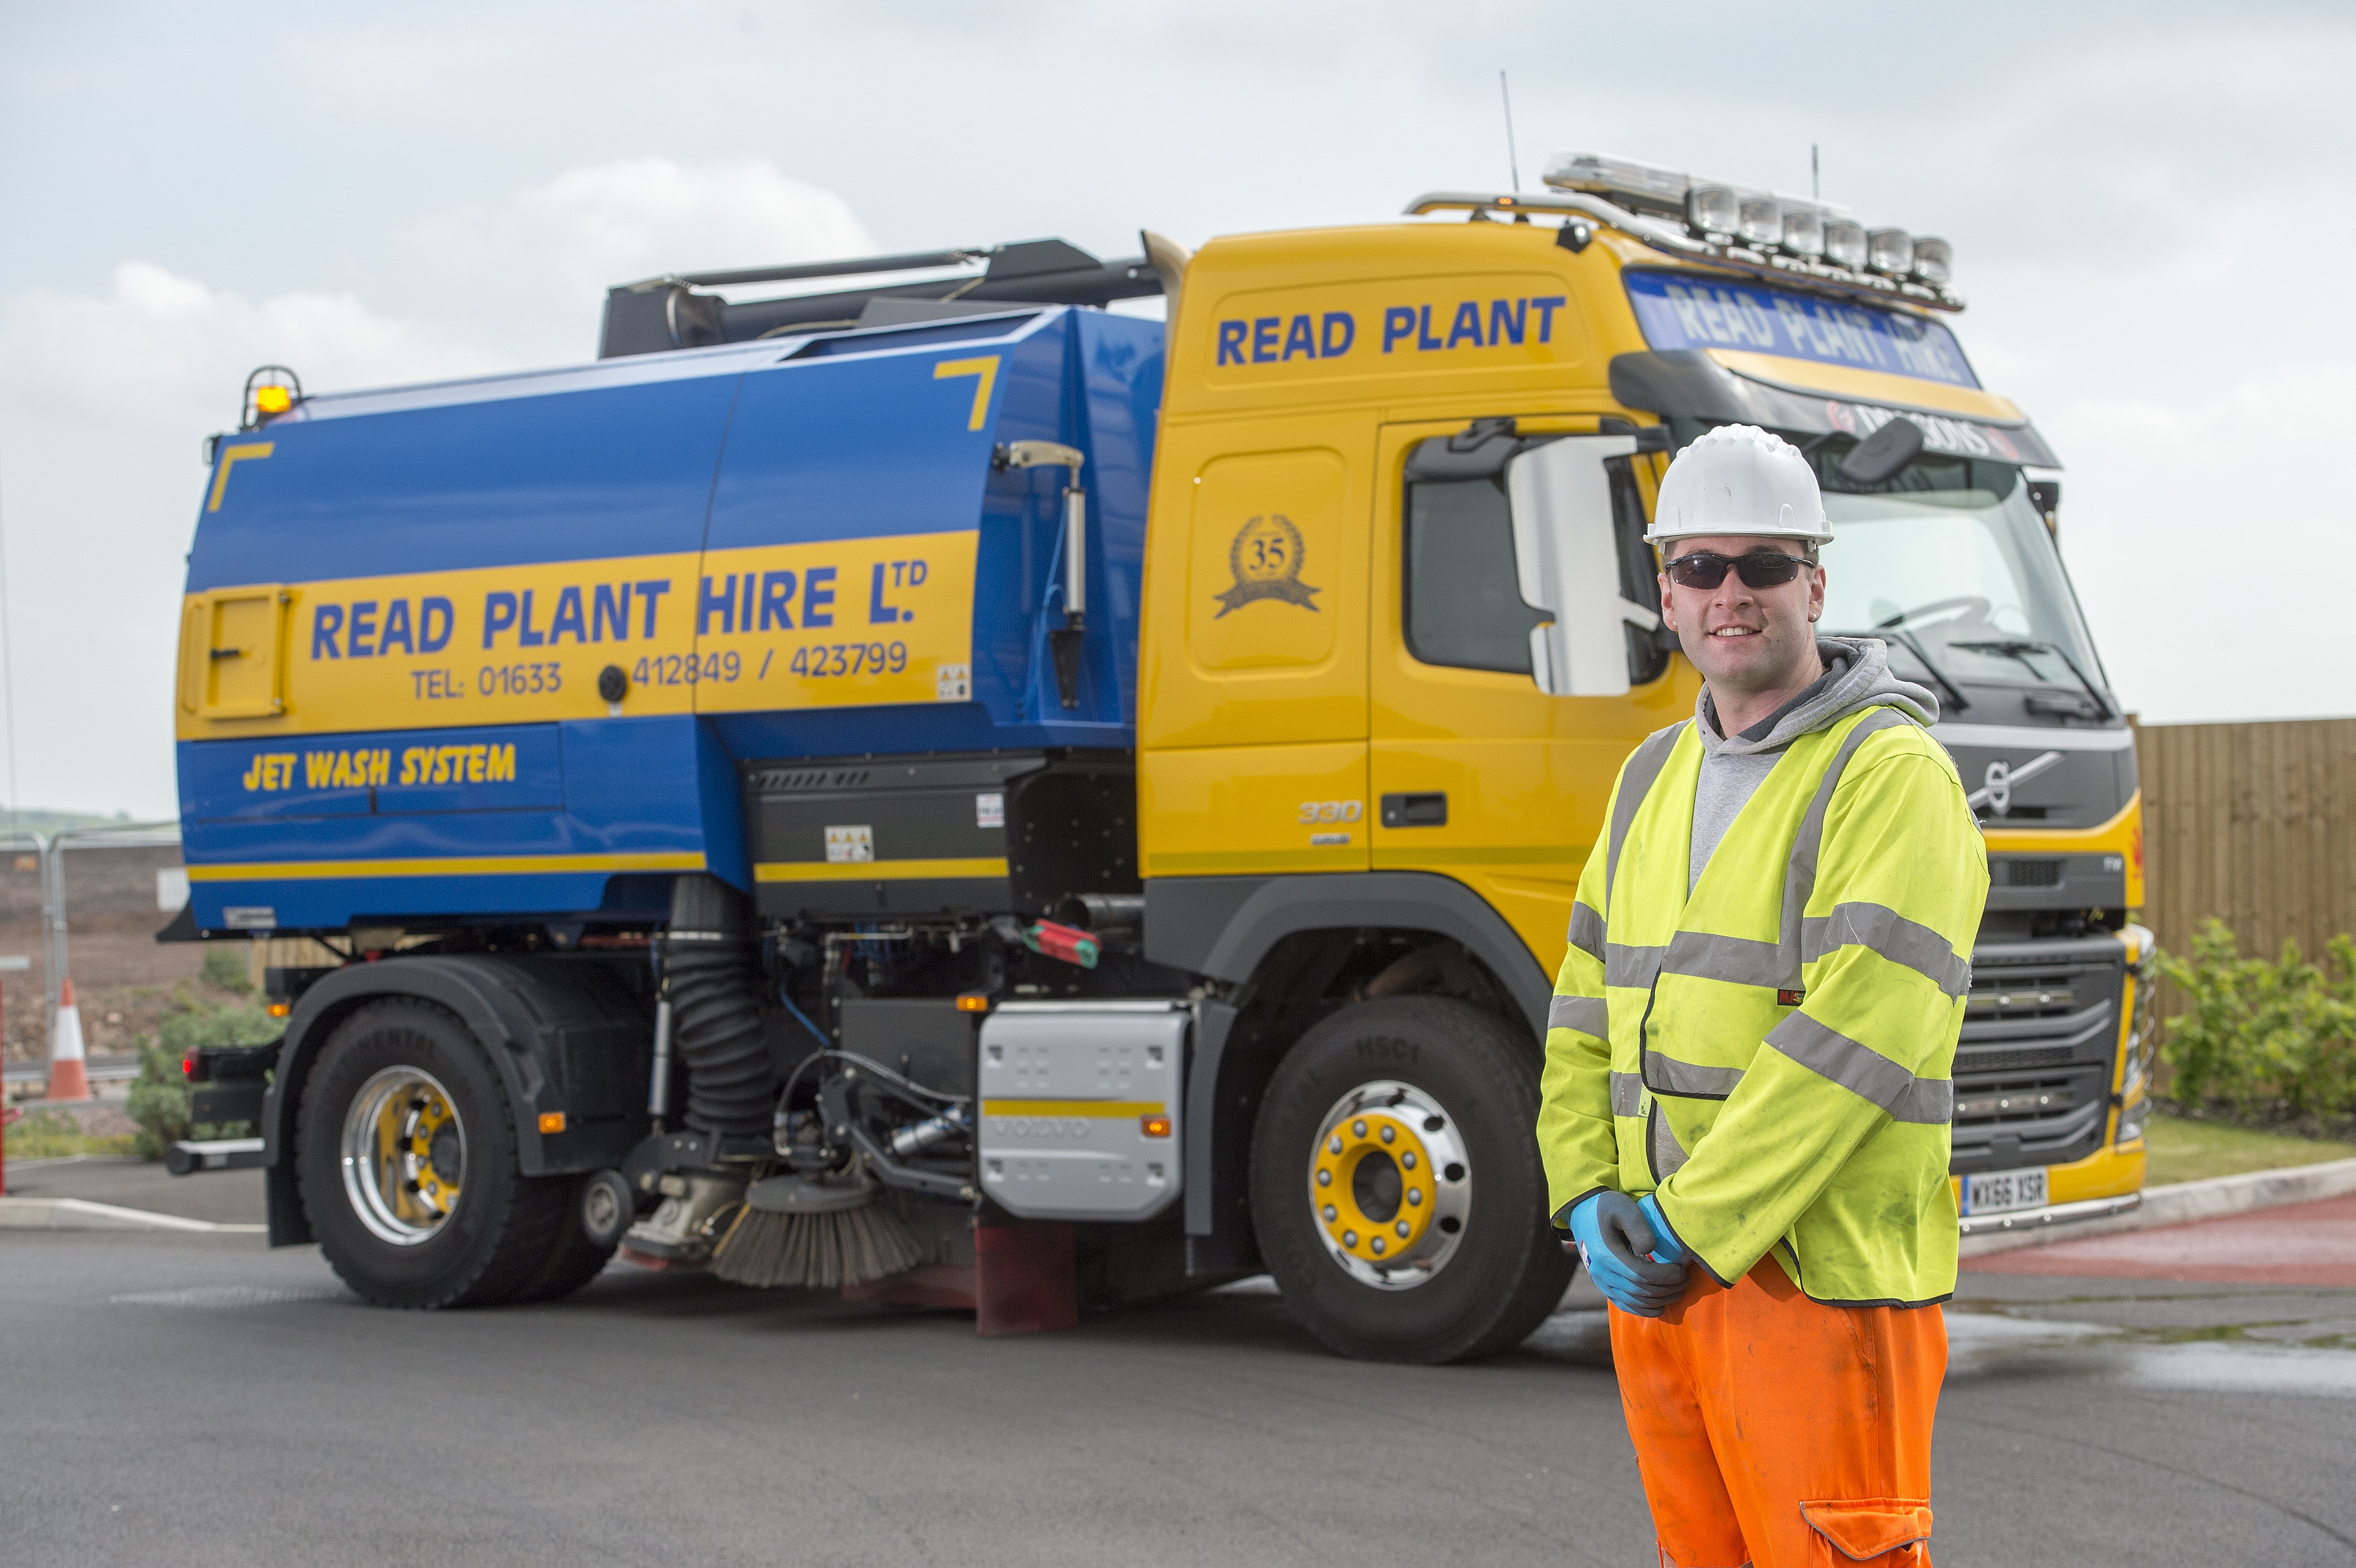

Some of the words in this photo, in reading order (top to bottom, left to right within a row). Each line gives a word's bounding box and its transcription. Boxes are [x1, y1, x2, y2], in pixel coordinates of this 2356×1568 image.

[1217, 311, 1356, 366] READ
[1382, 296, 1566, 353] PLANT
[1664, 284, 1776, 348] READ
[1776, 297, 1887, 367] PLANT
[1249, 537, 1285, 569] 35
[311, 596, 455, 661] READ
[482, 579, 671, 650] PLANT
[697, 566, 837, 636] HIRE
[410, 668, 464, 700] TEL:
[477, 661, 563, 697] 01633
[631, 649, 742, 687] 412849
[789, 640, 908, 678] 423799
[243, 753, 297, 791] JET
[305, 749, 391, 788] WASH
[400, 744, 515, 785] SYSTEM
[1298, 800, 1363, 824] 330
